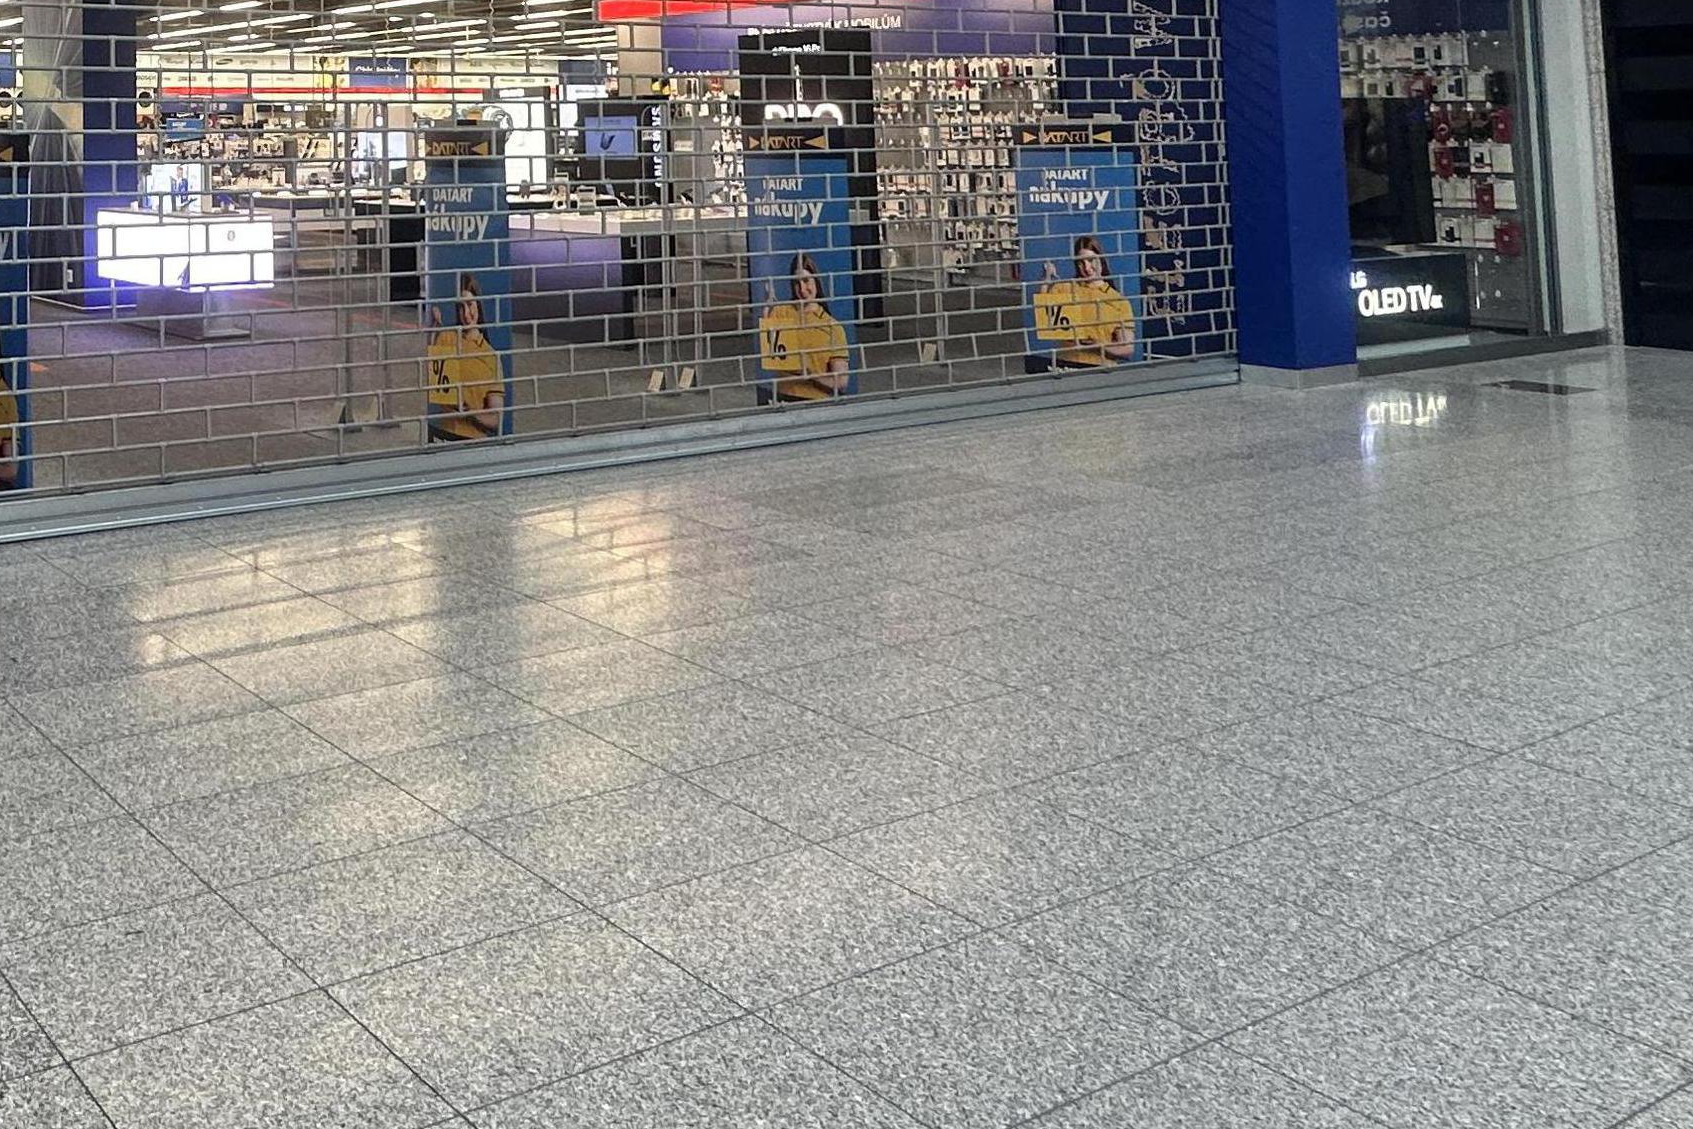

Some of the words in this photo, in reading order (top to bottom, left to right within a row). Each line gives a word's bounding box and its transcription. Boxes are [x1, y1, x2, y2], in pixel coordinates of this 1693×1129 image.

[1038, 131, 1089, 143] ATART
[1358, 286, 1407, 317] OLED
[1406, 284, 1432, 312] TV
